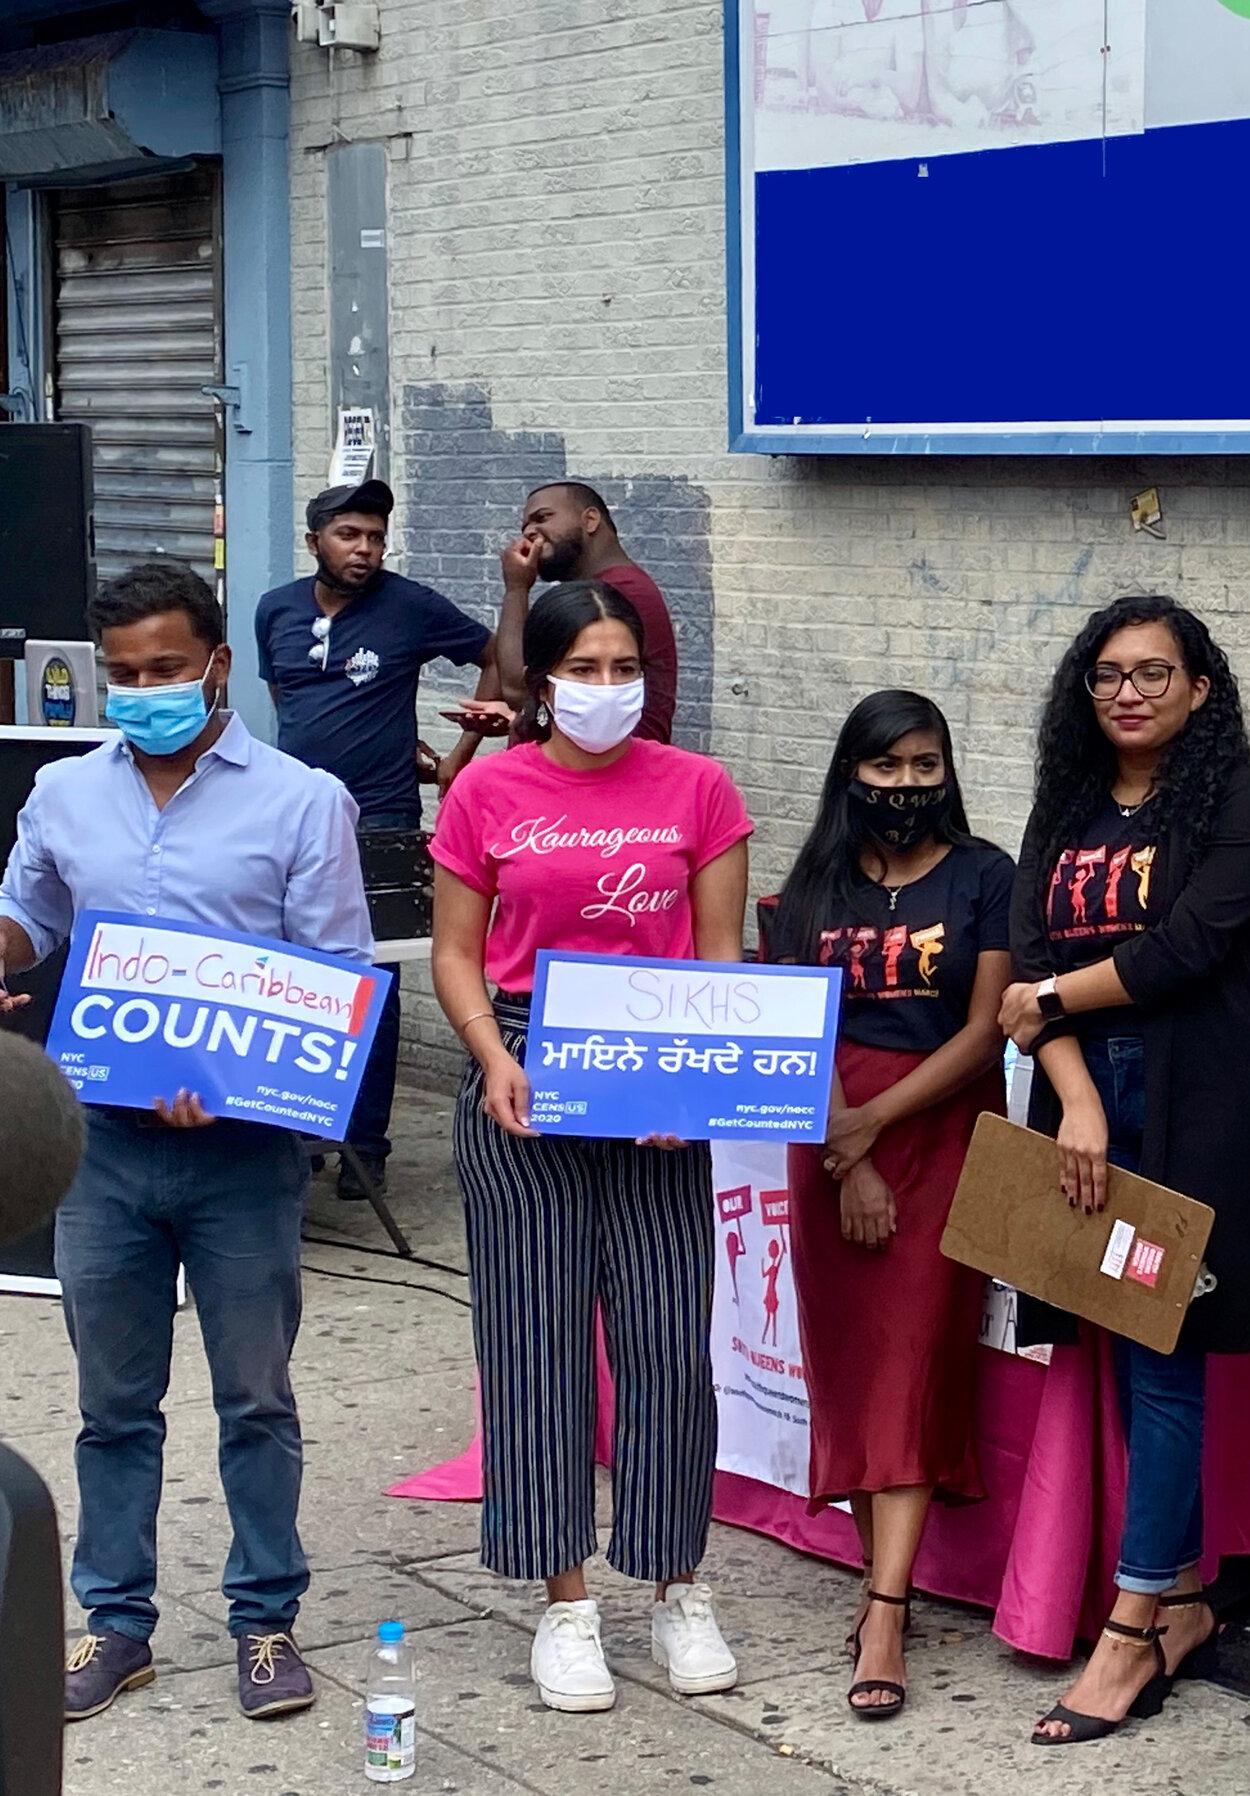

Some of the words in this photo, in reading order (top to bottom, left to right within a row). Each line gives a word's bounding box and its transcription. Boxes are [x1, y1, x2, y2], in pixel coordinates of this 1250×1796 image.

[490, 814, 682, 858] Kaurageous
[580, 863, 679, 927] Love
[88, 930, 353, 1018] Indo-Caribbean
[626, 970, 761, 1030] SIKHS
[71, 994, 358, 1081] COUNTS!
[541, 1035, 648, 1072] ਮਾਇਨੇ
[658, 1038, 743, 1075] ਰੱਖਦੇ
[753, 1049, 817, 1076] ਹਨ!
[60, 1052, 85, 1063] NYC
[225, 1096, 335, 1127] #GetCountedNYC
[256, 1085, 339, 1111] nyc.gov/nocc
[534, 1091, 560, 1100] NYC
[530, 1114, 562, 1123] 2020
[708, 1117, 814, 1130] #GetCountedNYC
